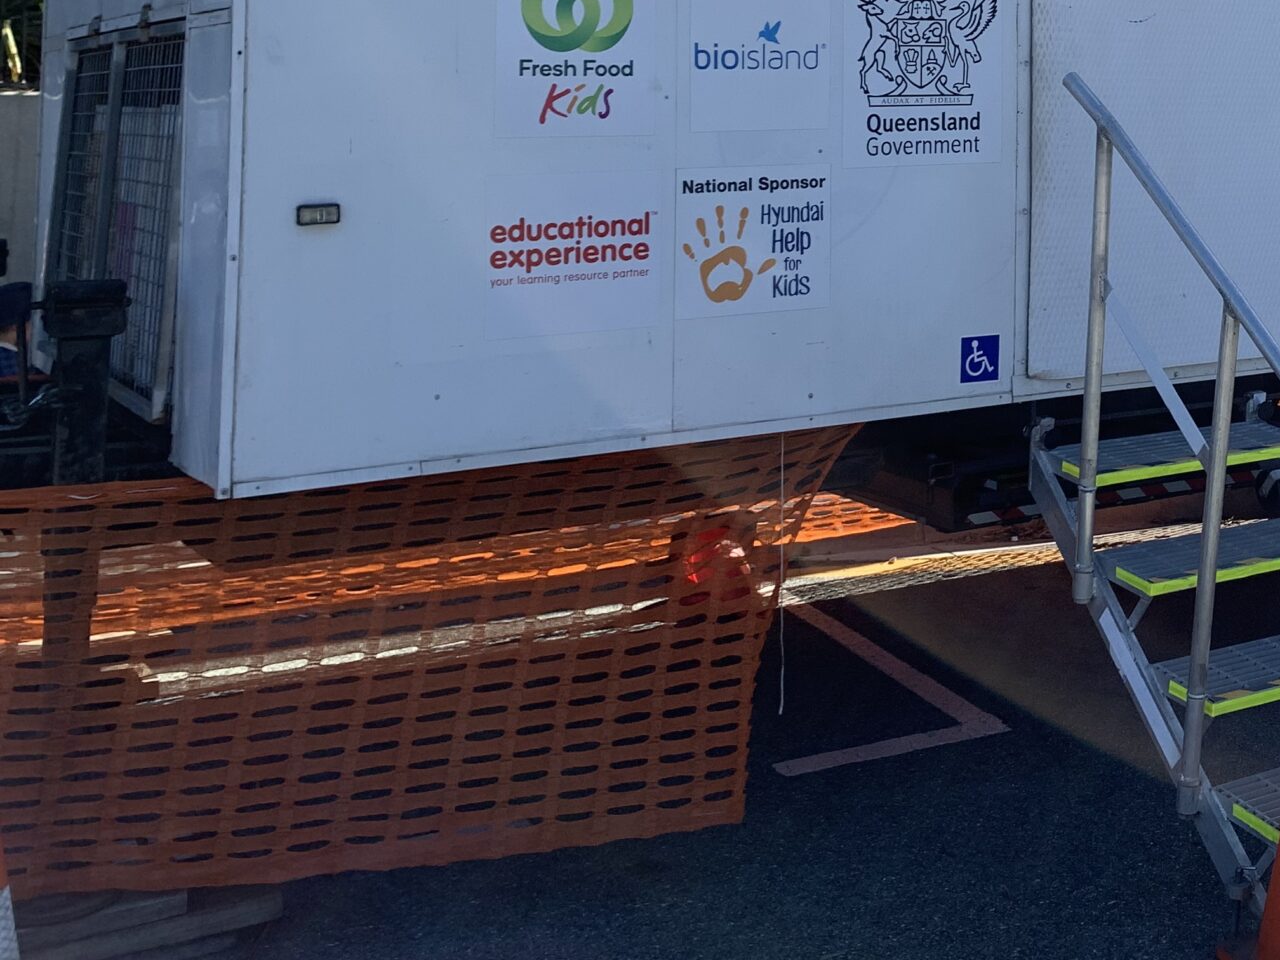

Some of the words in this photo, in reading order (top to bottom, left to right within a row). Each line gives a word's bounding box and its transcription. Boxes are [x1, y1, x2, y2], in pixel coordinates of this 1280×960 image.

[519, 59, 577, 77] Fresh
[583, 59, 634, 77] Food
[694, 42, 819, 70] bioisland
[539, 83, 614, 125] Kids
[881, 97, 909, 105] AUDAX
[929, 96, 961, 104] FIDELIS
[866, 111, 981, 136] Queensland
[866, 136, 980, 157] Government
[682, 177, 753, 194] National
[758, 176, 826, 193] Sponsor
[760, 201, 825, 227] Hyundai
[489, 210, 651, 244] educational
[771, 227, 812, 255] Help
[489, 239, 650, 274] experience
[784, 256, 802, 271] for
[490, 276, 513, 289] your
[517, 273, 560, 285] learning
[564, 269, 608, 282] resource
[612, 267, 650, 280] partner
[772, 273, 812, 299] Kids
